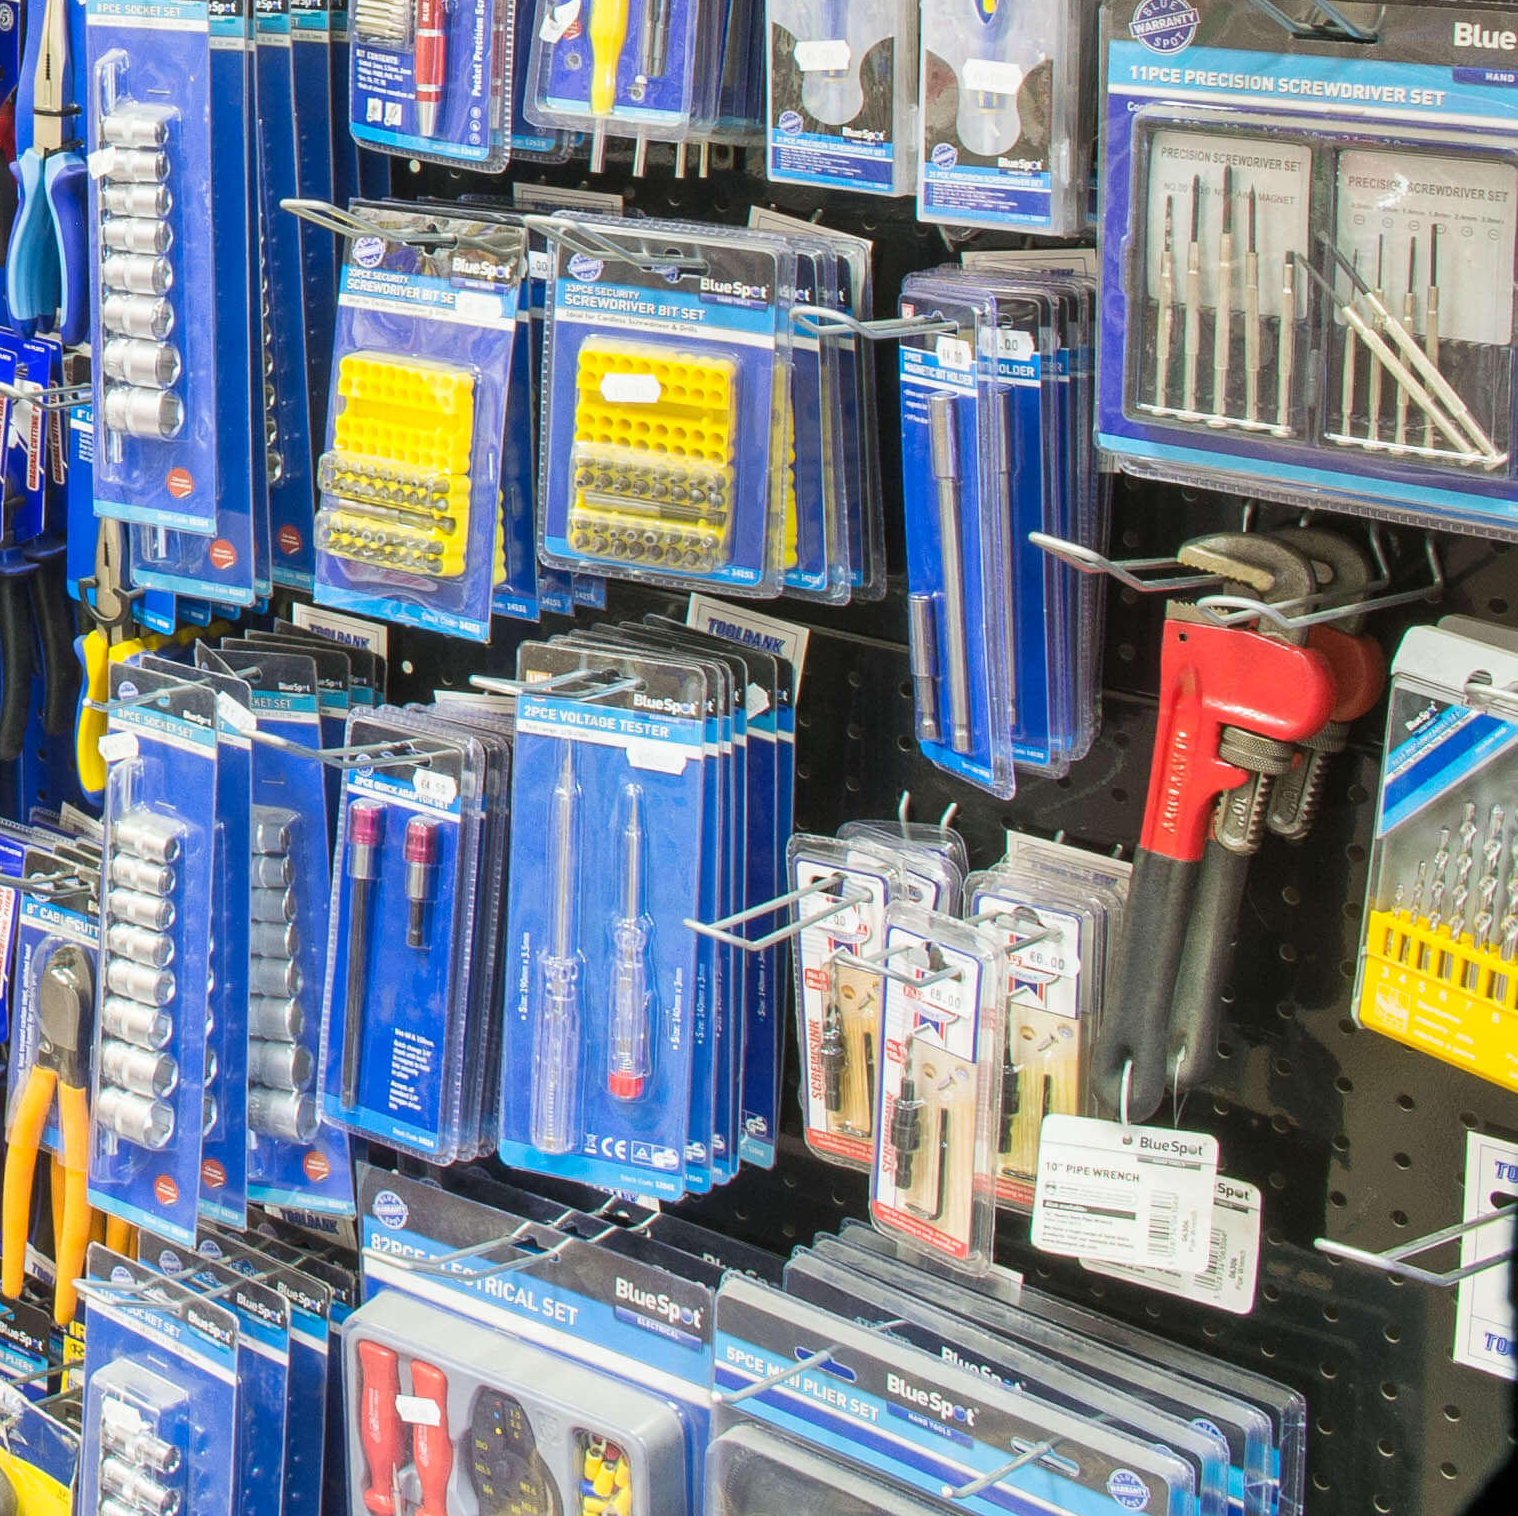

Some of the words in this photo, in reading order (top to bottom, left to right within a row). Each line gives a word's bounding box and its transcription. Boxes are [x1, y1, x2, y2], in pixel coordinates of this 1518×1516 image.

[124, 4, 159, 18] SOCKET
[162, 6, 181, 18] SET
[1132, 11, 1199, 32] WARRANTY
[473, 17, 483, 61] Precision
[1153, 33, 1185, 49] SPOT
[1454, 22, 1515, 50] Blue
[471, 63, 482, 97] Pocket
[1129, 65, 1181, 84] 11PCE
[1184, 68, 1274, 93] PRECISION
[1278, 77, 1406, 104] SCREWDRIVER
[1411, 89, 1445, 107] SET
[1486, 72, 1514, 83] HAND
[1161, 146, 1210, 163] PRECISION
[1213, 154, 1281, 170] SCREWDRIVER
[1284, 160, 1302, 172] SET
[1488, 189, 1508, 203] SET
[451, 258, 513, 280] BlueSpot
[597, 287, 639, 300] SECURITY
[699, 276, 767, 300] BlueSpot
[564, 294, 653, 314] SCREWDRIVER
[657, 302, 681, 318] BIT
[683, 306, 705, 322] SET
[707, 617, 787, 652] TOOLBANK
[633, 693, 698, 717] BlueSpot
[524, 704, 555, 721] 2PCE
[560, 709, 616, 732] VOLTAGE
[619, 717, 670, 738] TESTER
[810, 1021, 823, 1101] SCREWSINK
[1139, 1136, 1204, 1156] BlueSpot
[1045, 1161, 1064, 1172] 10"
[1066, 1164, 1090, 1175] PIPE
[1093, 1168, 1140, 1182] WRENCH
[542, 1300, 579, 1326] SET
[615, 1276, 703, 1330] BlueSpot
[636, 1316, 679, 1339] ELECTRICAL
[725, 1346, 762, 1371] 5PCE
[803, 1379, 847, 1410] PLIER
[849, 1398, 879, 1422] SET
[887, 1373, 974, 1427] BlueSpot
